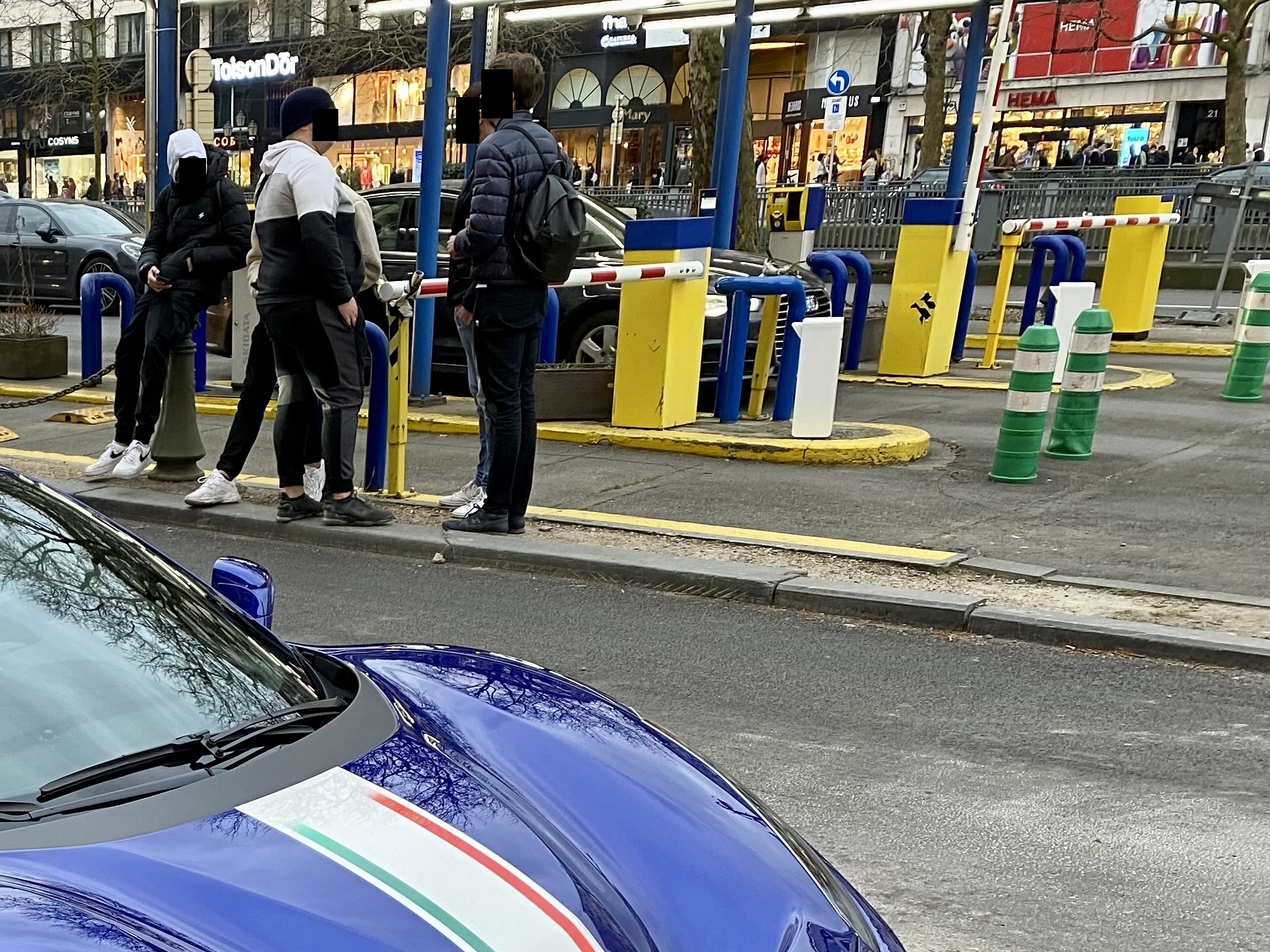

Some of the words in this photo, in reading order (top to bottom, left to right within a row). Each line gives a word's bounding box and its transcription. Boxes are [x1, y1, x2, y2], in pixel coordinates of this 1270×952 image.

[1007, 89, 1058, 108] HEMA
[623, 108, 652, 123] Mary
[1207, 109, 1219, 118] 21
[47, 135, 80, 147] COSYNS
[242, 312, 251, 365] SKIDATA
